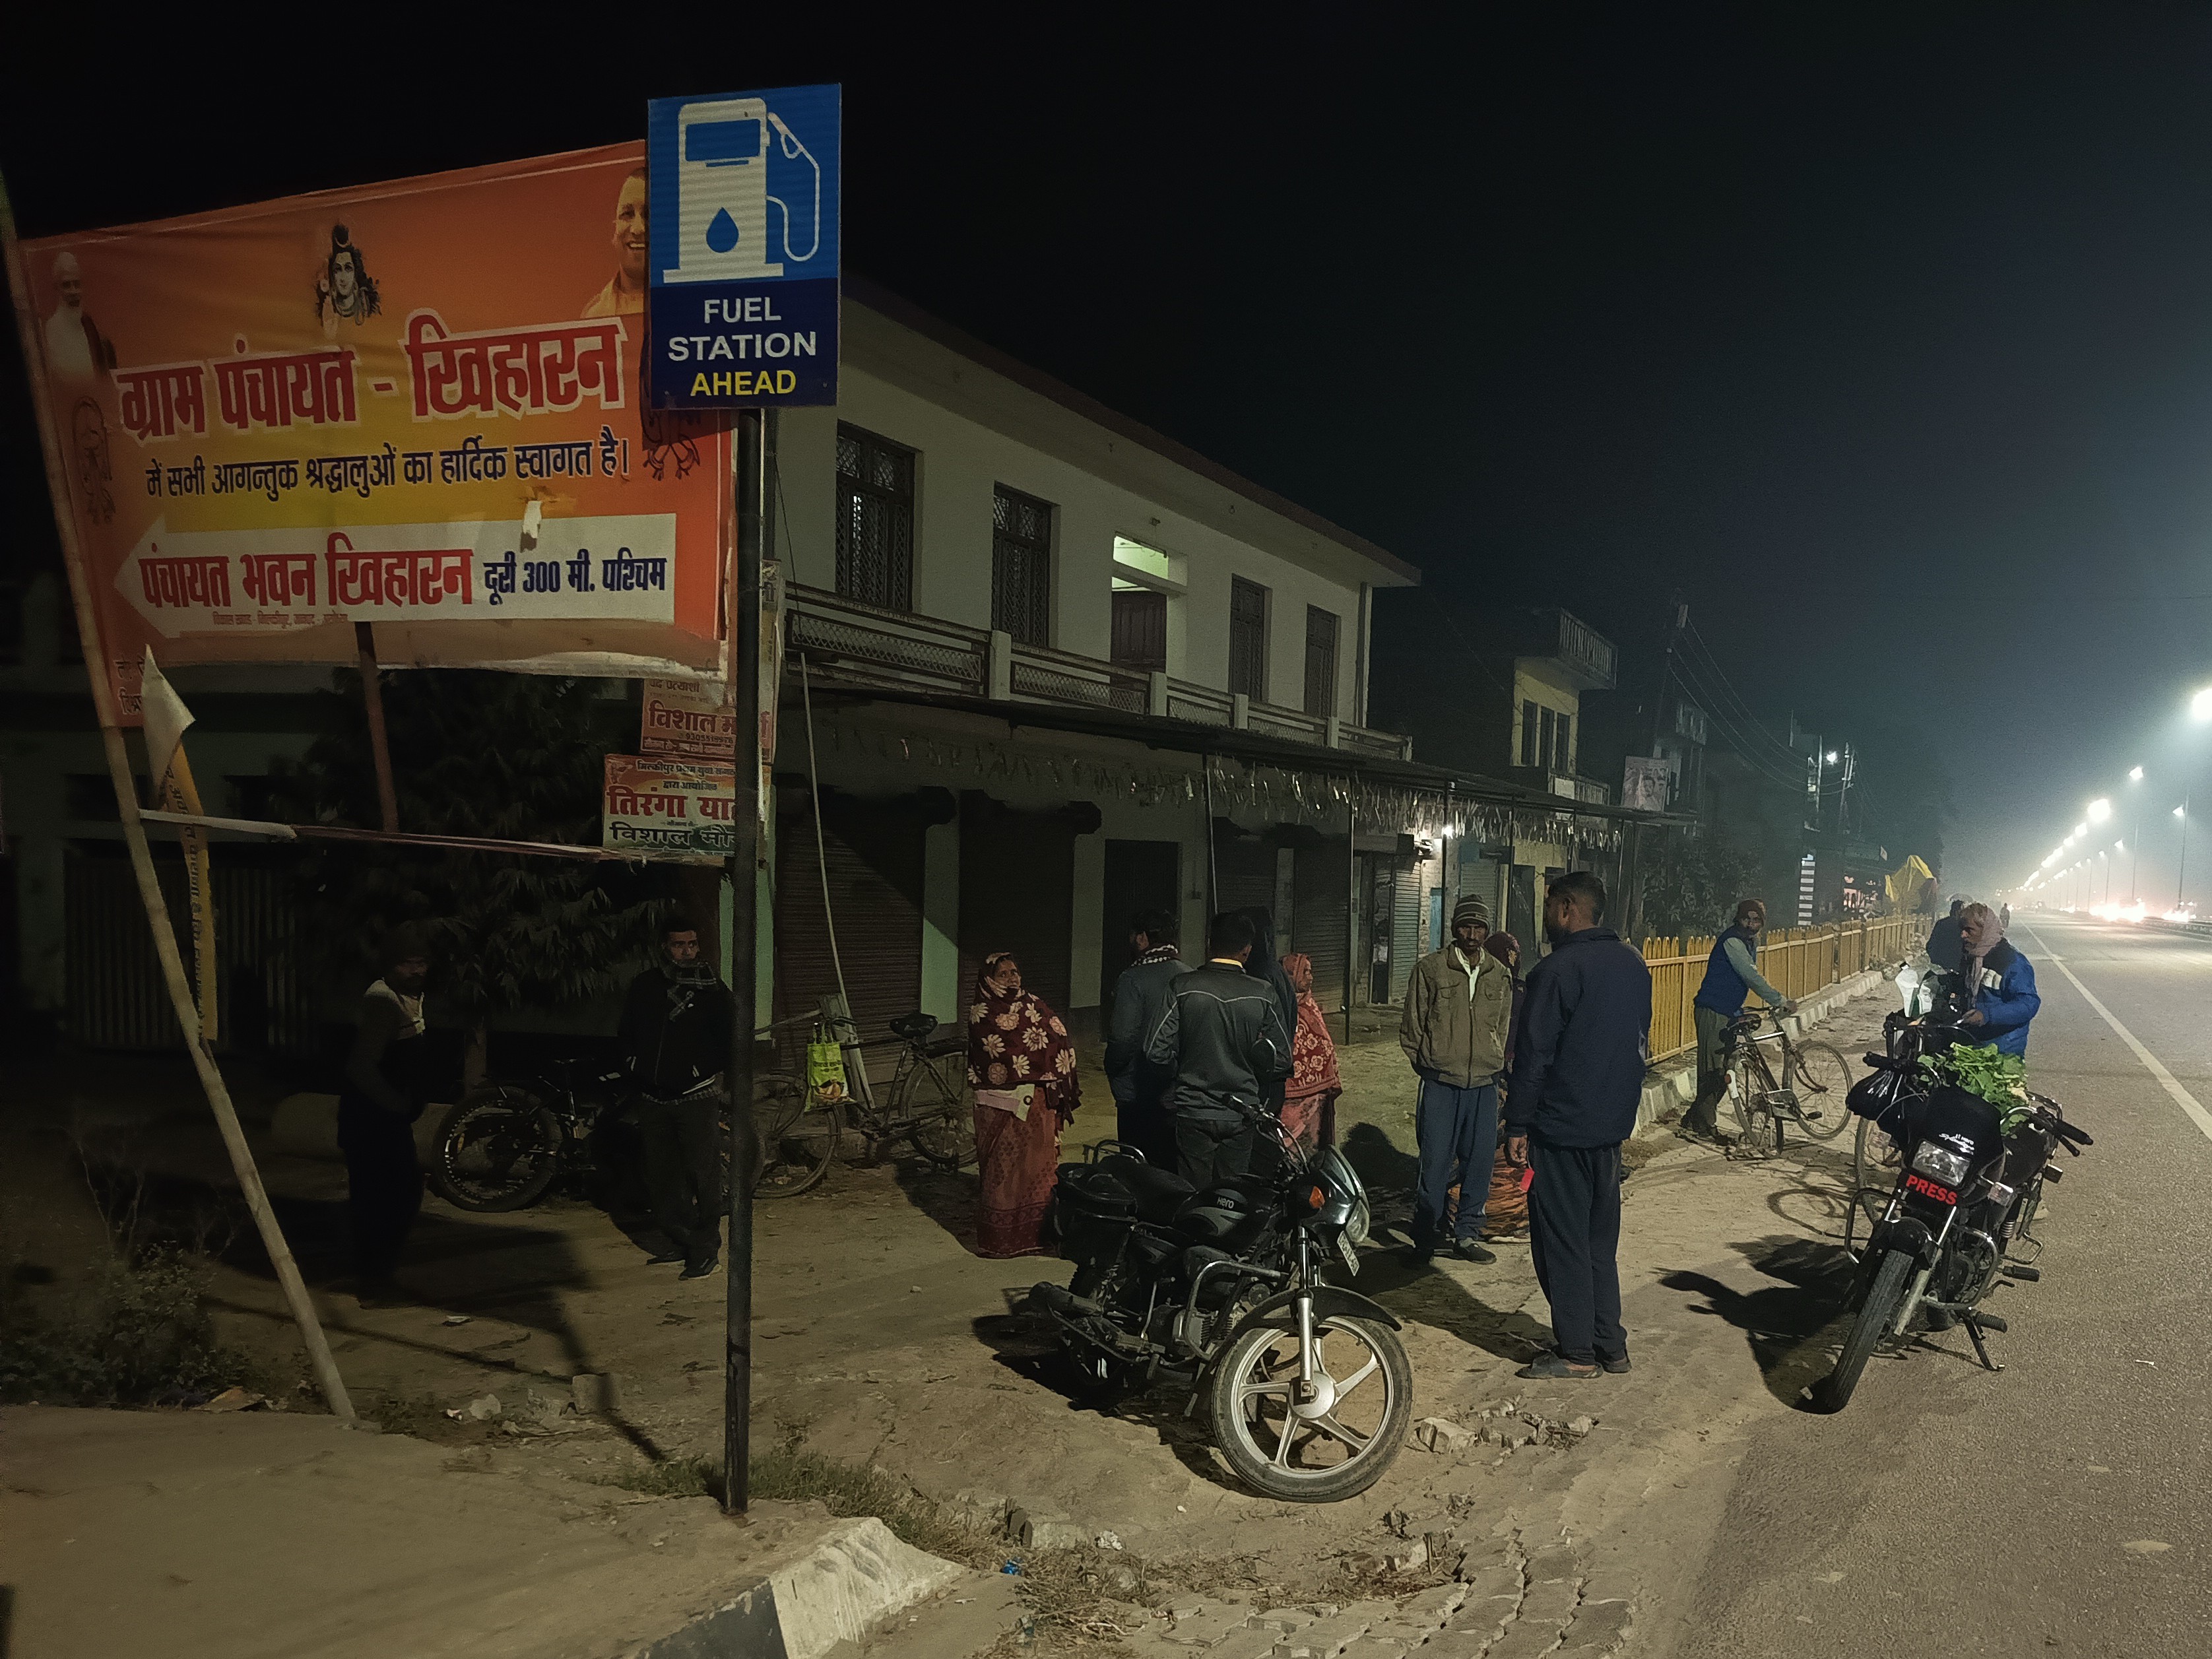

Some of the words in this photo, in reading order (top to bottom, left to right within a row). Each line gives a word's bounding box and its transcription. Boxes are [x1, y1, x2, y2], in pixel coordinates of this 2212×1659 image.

[704, 297, 781, 324] FUEL
[668, 331, 816, 362] STATION
[117, 365, 206, 438] ग्राम
[214, 339, 356, 430] पंचायत
[405, 314, 622, 416] खिहारन
[690, 370, 796, 397] AHEAD
[146, 458, 163, 498] में
[167, 455, 205, 496] सभी
[211, 460, 298, 502] आगन्तुक
[306, 443, 397, 498] श्रद्धालुओं
[405, 451, 432, 484] का
[440, 436, 508, 484] हार्दिक
[514, 440, 593, 478] स्वागत
[139, 543, 231, 607] पंचायत
[241, 554, 316, 606] भवन
[325, 532, 472, 606] खिहारन
[483, 551, 516, 605] दूरी
[523, 560, 560, 592] 300
[566, 548, 595, 593] मी.
[649, 699, 718, 733] विशाल
[606, 785, 688, 818] तिरंगा
[610, 821, 692, 845] विशाल
[1216, 1196, 1235, 1209] Hero
[1906, 1173, 1959, 1206] PRESS
